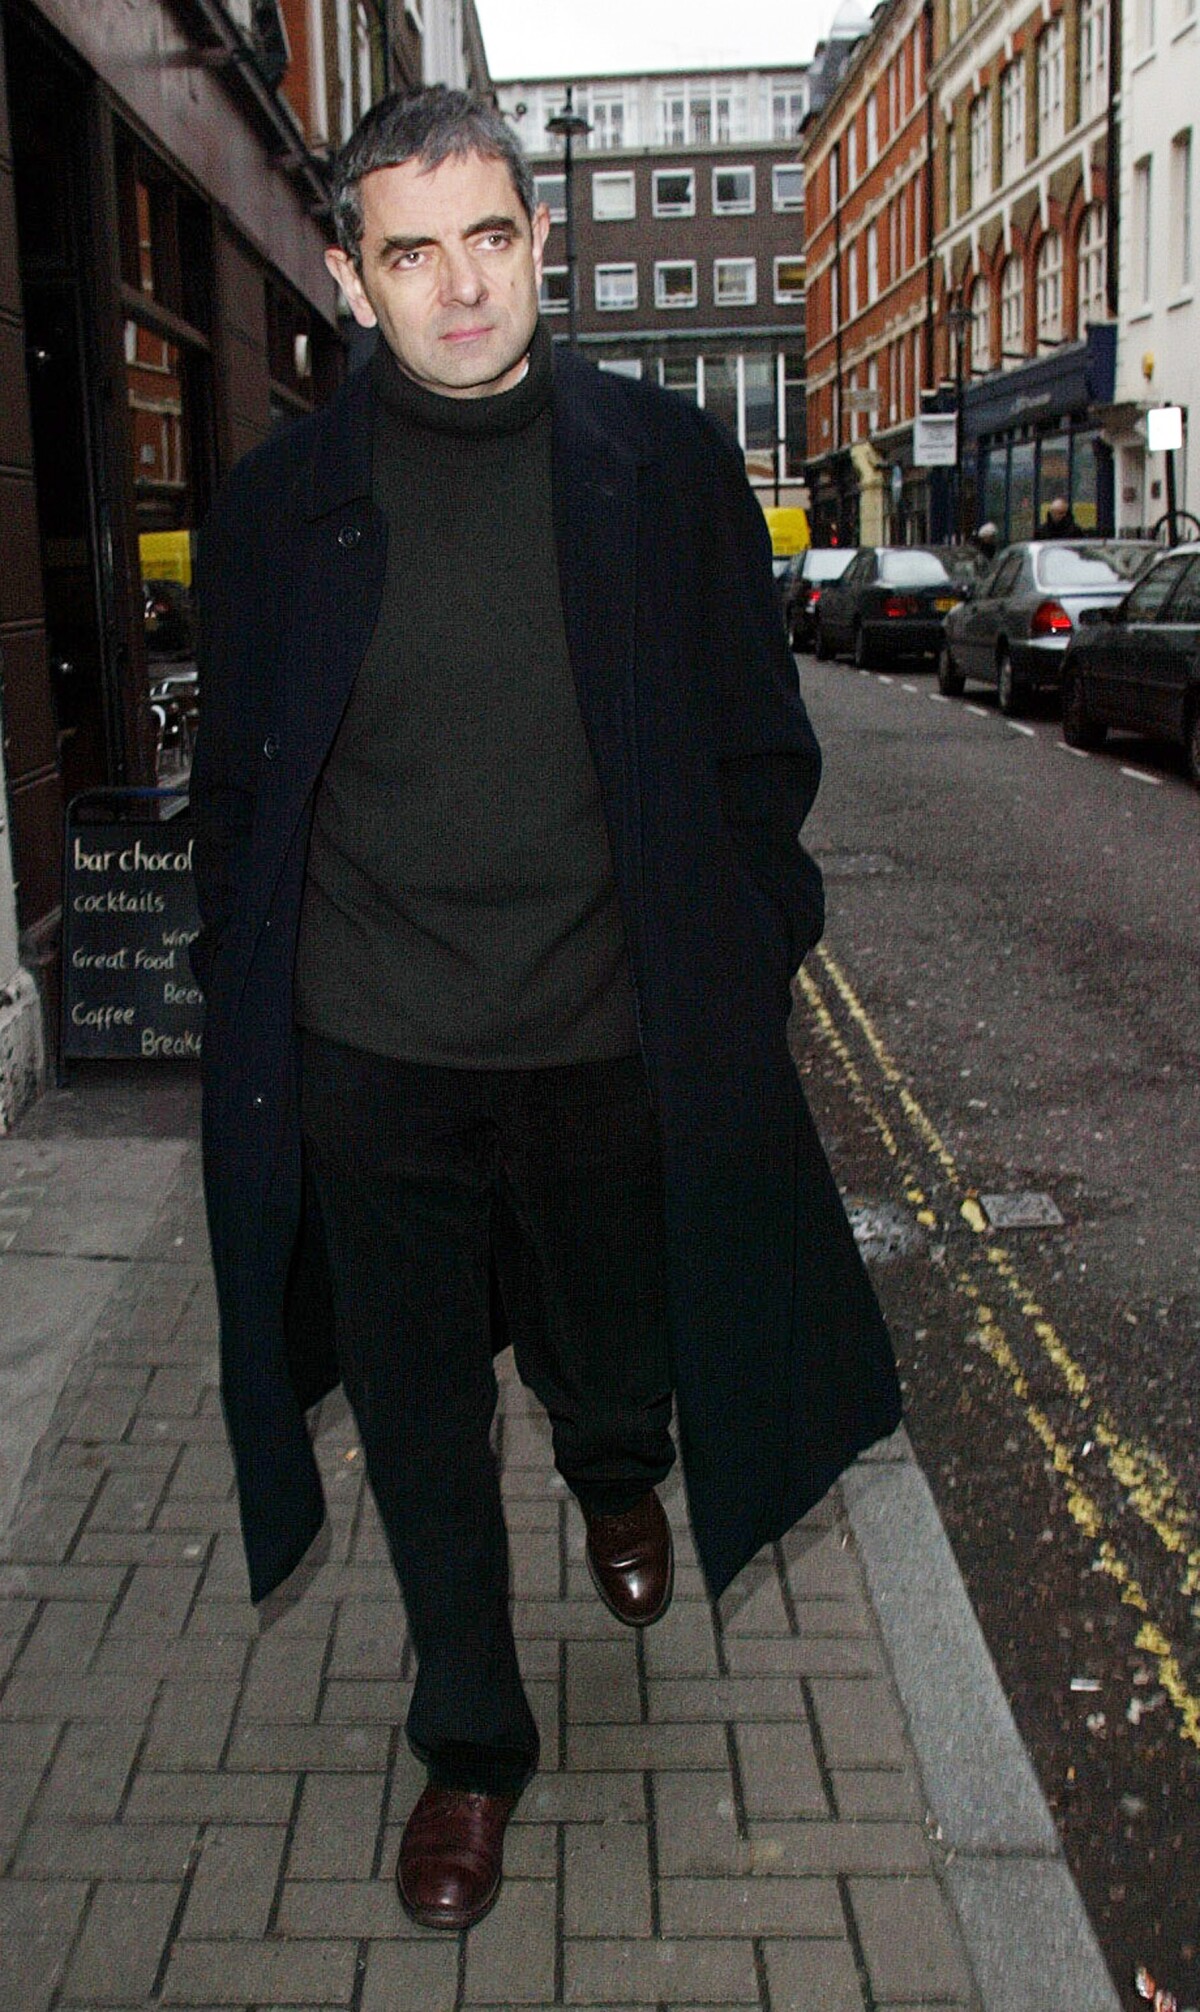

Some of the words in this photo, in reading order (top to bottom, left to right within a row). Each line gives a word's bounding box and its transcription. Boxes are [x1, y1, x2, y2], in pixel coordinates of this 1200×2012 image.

[75, 837, 117, 871] bar
[74, 889, 165, 912] cocktails
[72, 945, 127, 970] Great
[71, 1001, 135, 1031] Coffee
